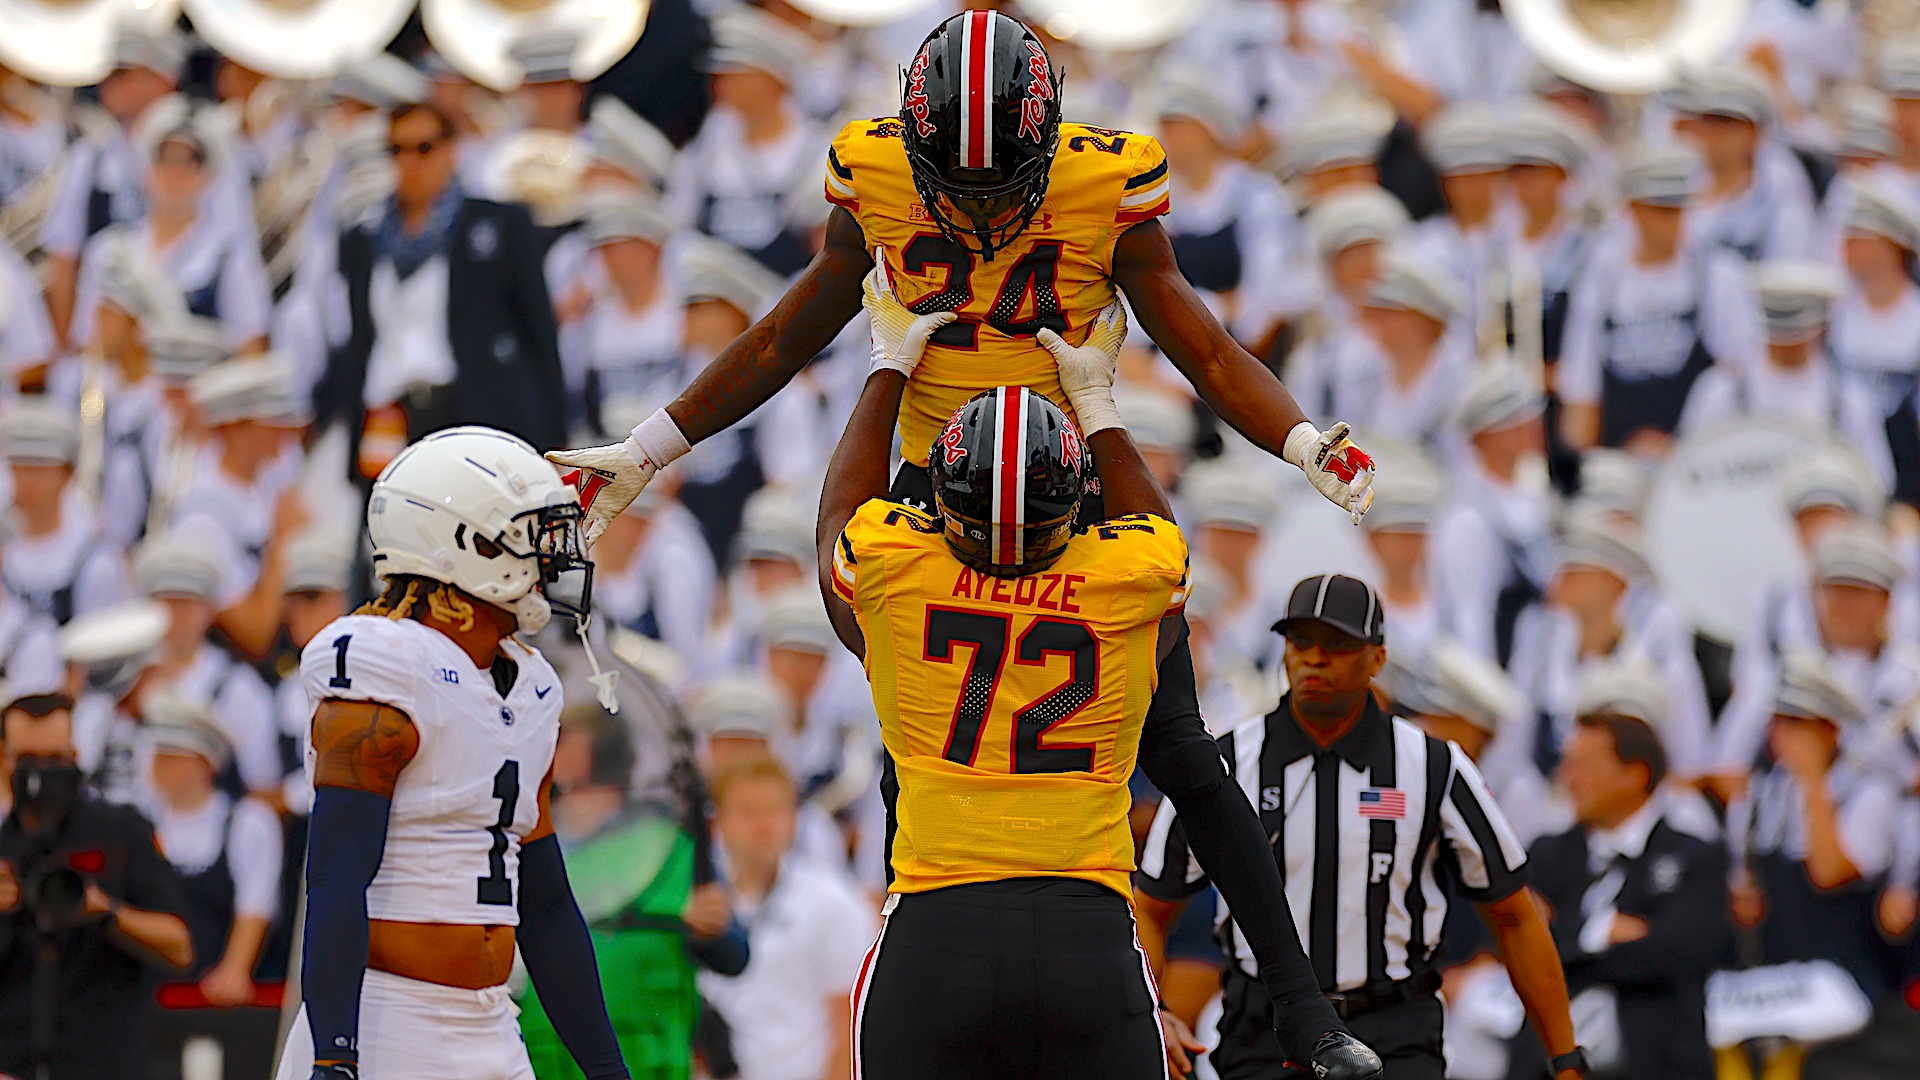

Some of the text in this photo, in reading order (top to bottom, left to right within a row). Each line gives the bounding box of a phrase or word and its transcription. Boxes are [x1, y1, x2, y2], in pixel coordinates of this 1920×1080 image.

[1018, 41, 1054, 143] Terps
[900, 231, 1071, 352] 24
[952, 566, 1086, 613] AYEDZE
[329, 634, 353, 689] 1
[923, 604, 1100, 774] 72
[476, 759, 520, 906] 1
[1262, 786, 1281, 811] S
[1371, 852, 1393, 884] F
